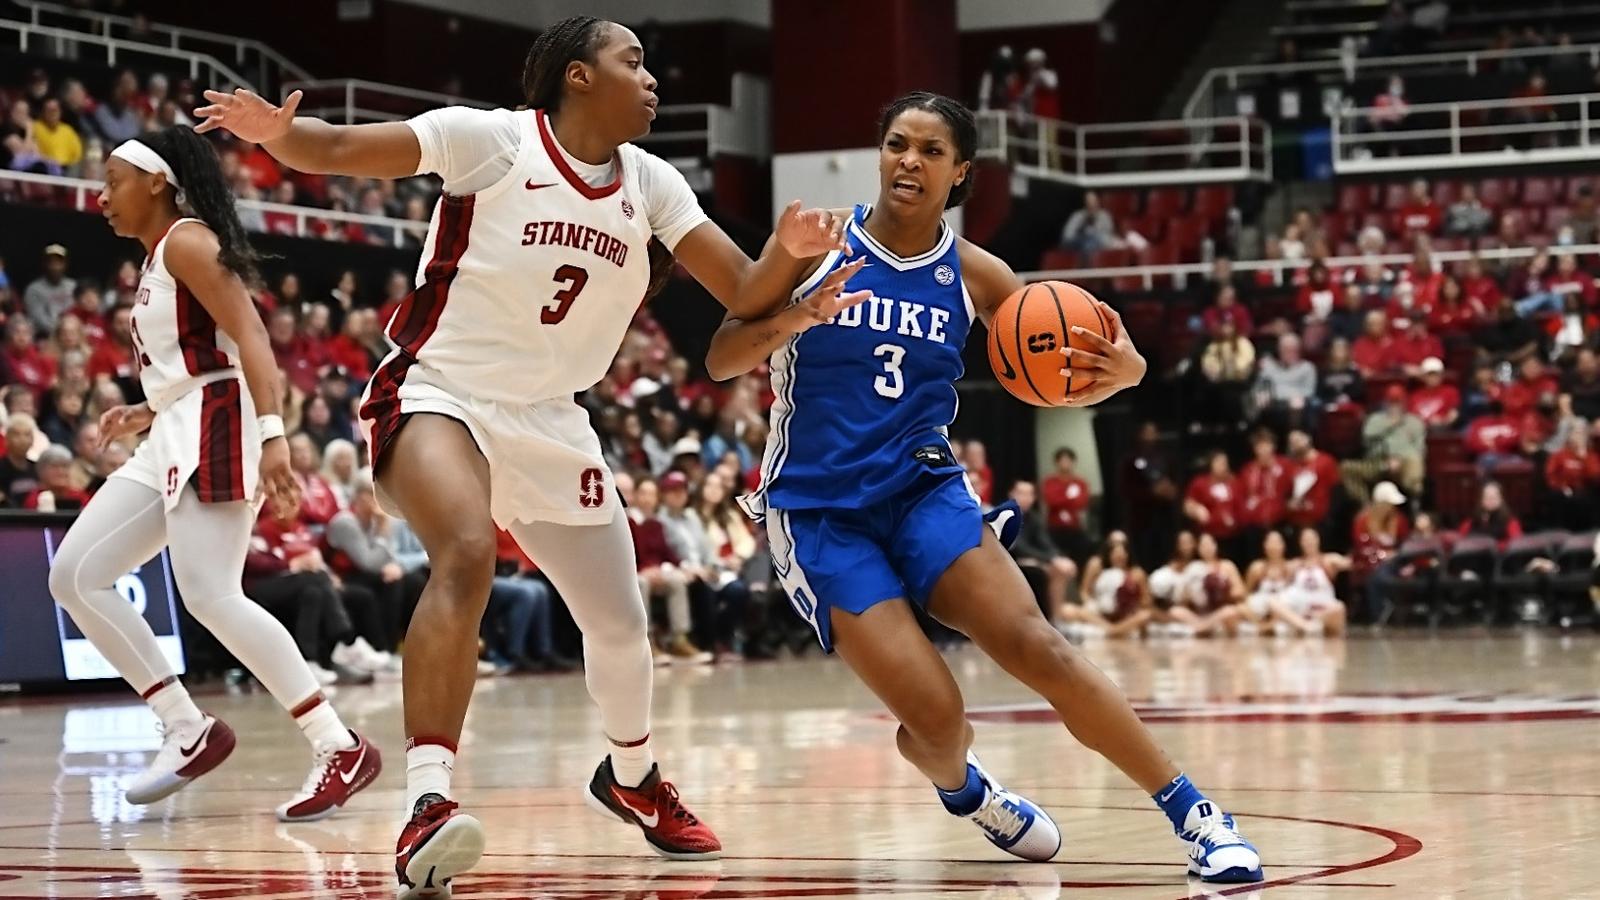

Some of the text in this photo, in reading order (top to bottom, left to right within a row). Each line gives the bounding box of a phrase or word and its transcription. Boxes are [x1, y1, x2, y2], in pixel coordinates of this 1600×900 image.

[521, 221, 629, 268] STANFORD
[540, 264, 589, 325] 3
[838, 292, 950, 344] DUKE
[873, 343, 906, 399] 3
[579, 468, 604, 508] S
